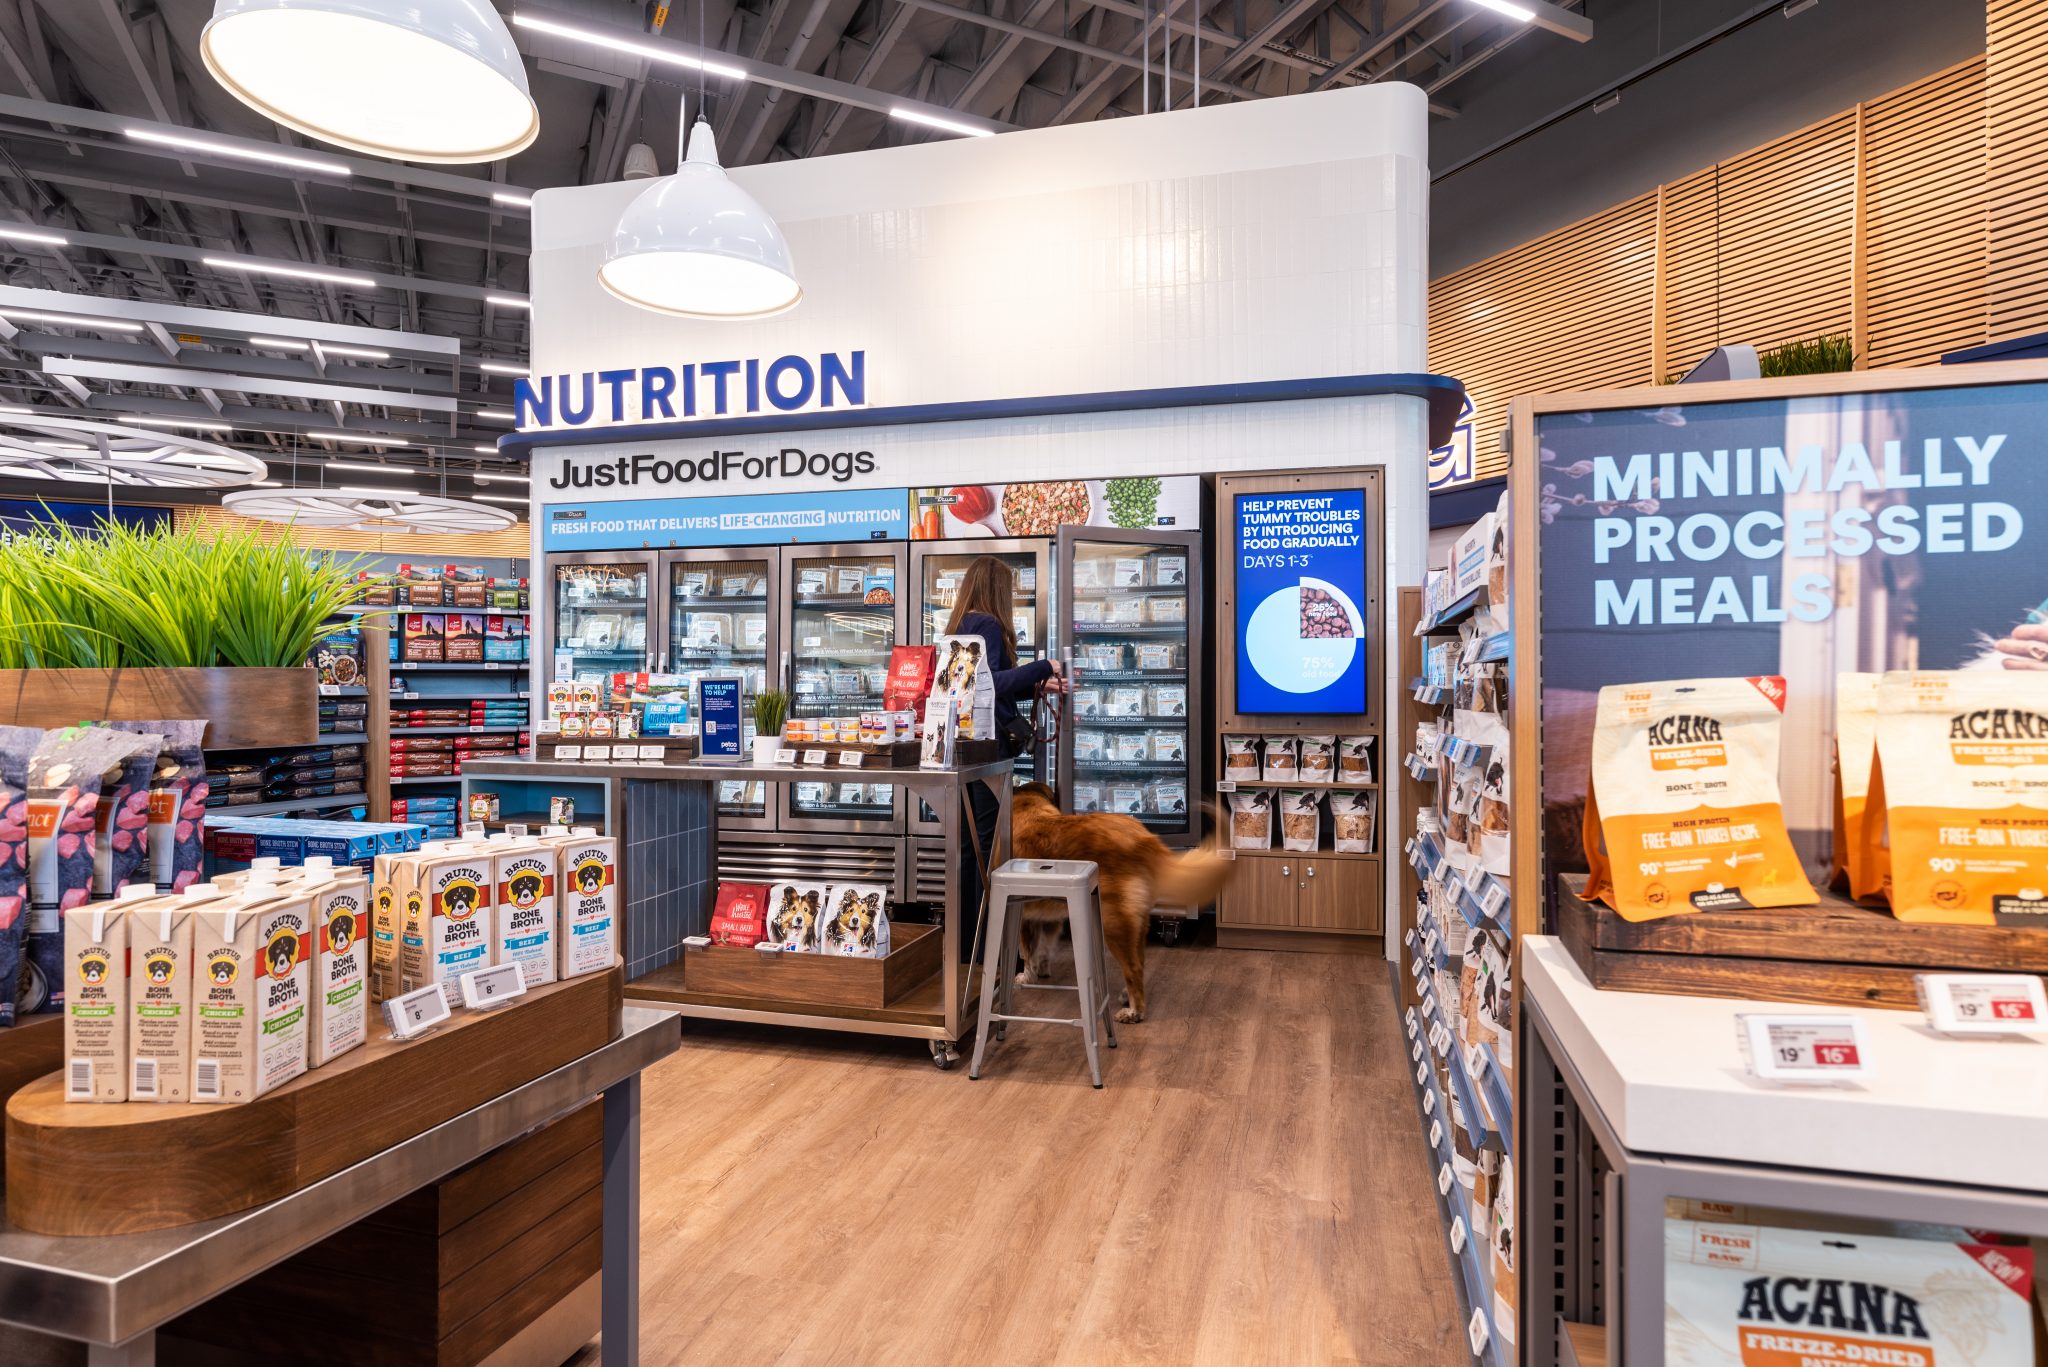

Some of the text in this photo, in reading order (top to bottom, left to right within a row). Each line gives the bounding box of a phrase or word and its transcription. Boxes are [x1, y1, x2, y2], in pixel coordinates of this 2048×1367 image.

[514, 351, 865, 428] NUTRITION
[550, 449, 875, 489] JustFoodForDogs
[1593, 435, 2008, 502] MINIMALLY
[1243, 498, 1334, 512] HELP PREVENT
[551, 509, 901, 535] FRESH FOOD THAT DELIVERS LIFE-CHANGING NUTRITION
[1243, 509, 1361, 524] TUMMY TROUBLES
[1243, 523, 1353, 537] BY INTRODUCING
[1594, 502, 2024, 564] PROCESSED
[1243, 535, 1360, 550] FOOD GRADUALLY
[1243, 555, 1285, 569] DAYS
[1312, 602, 1335, 612] 25%
[1594, 573, 1834, 626] MEALS
[1303, 657, 1335, 669] 75%
[1757, 677, 1783, 700] NEW!
[649, 713, 680, 723] ORIGINAL
[1949, 708, 2048, 739] ACANA
[1648, 715, 1723, 746] ACANA
[1665, 783, 1694, 792] BONE
[1672, 817, 1731, 828] HIGH PROTEIN
[1641, 829, 1694, 850] FREE-RUN
[1939, 827, 2006, 846] FREE-RUN
[334, 841, 347, 850] STEW
[573, 849, 608, 866] BRUTUS
[505, 858, 547, 877] BRUTUS
[438, 868, 483, 888] BRUTUS
[325, 895, 359, 918] BRUTUS
[577, 903, 606, 916] BROTH
[580, 897, 603, 908] BONE
[510, 916, 544, 929] BROTH
[512, 909, 540, 921] BONE
[264, 914, 303, 940] BRUTUS
[447, 920, 476, 933] BONE
[584, 924, 600, 932] BEEF
[444, 929, 480, 943] BROTH
[518, 938, 536, 947] BEEF
[77, 947, 112, 960] BRUTUS
[144, 947, 178, 960] BRUTUS
[207, 948, 241, 961] BRUTUS
[453, 951, 473, 961] BEEF
[332, 954, 354, 970] BONE
[331, 963, 357, 981] BROTH
[270, 978, 296, 995] BONE
[268, 987, 299, 1008] BROTH
[270, 1013, 299, 1030] CHICKEN
[1701, 1201, 1735, 1214] RAW
[1700, 1233, 1752, 1249] FRESH
[1707, 1252, 1744, 1263] RAW
[1737, 1276, 1931, 1340] ACANA
[1745, 1332, 1926, 1367] FREEZE-DRIED
